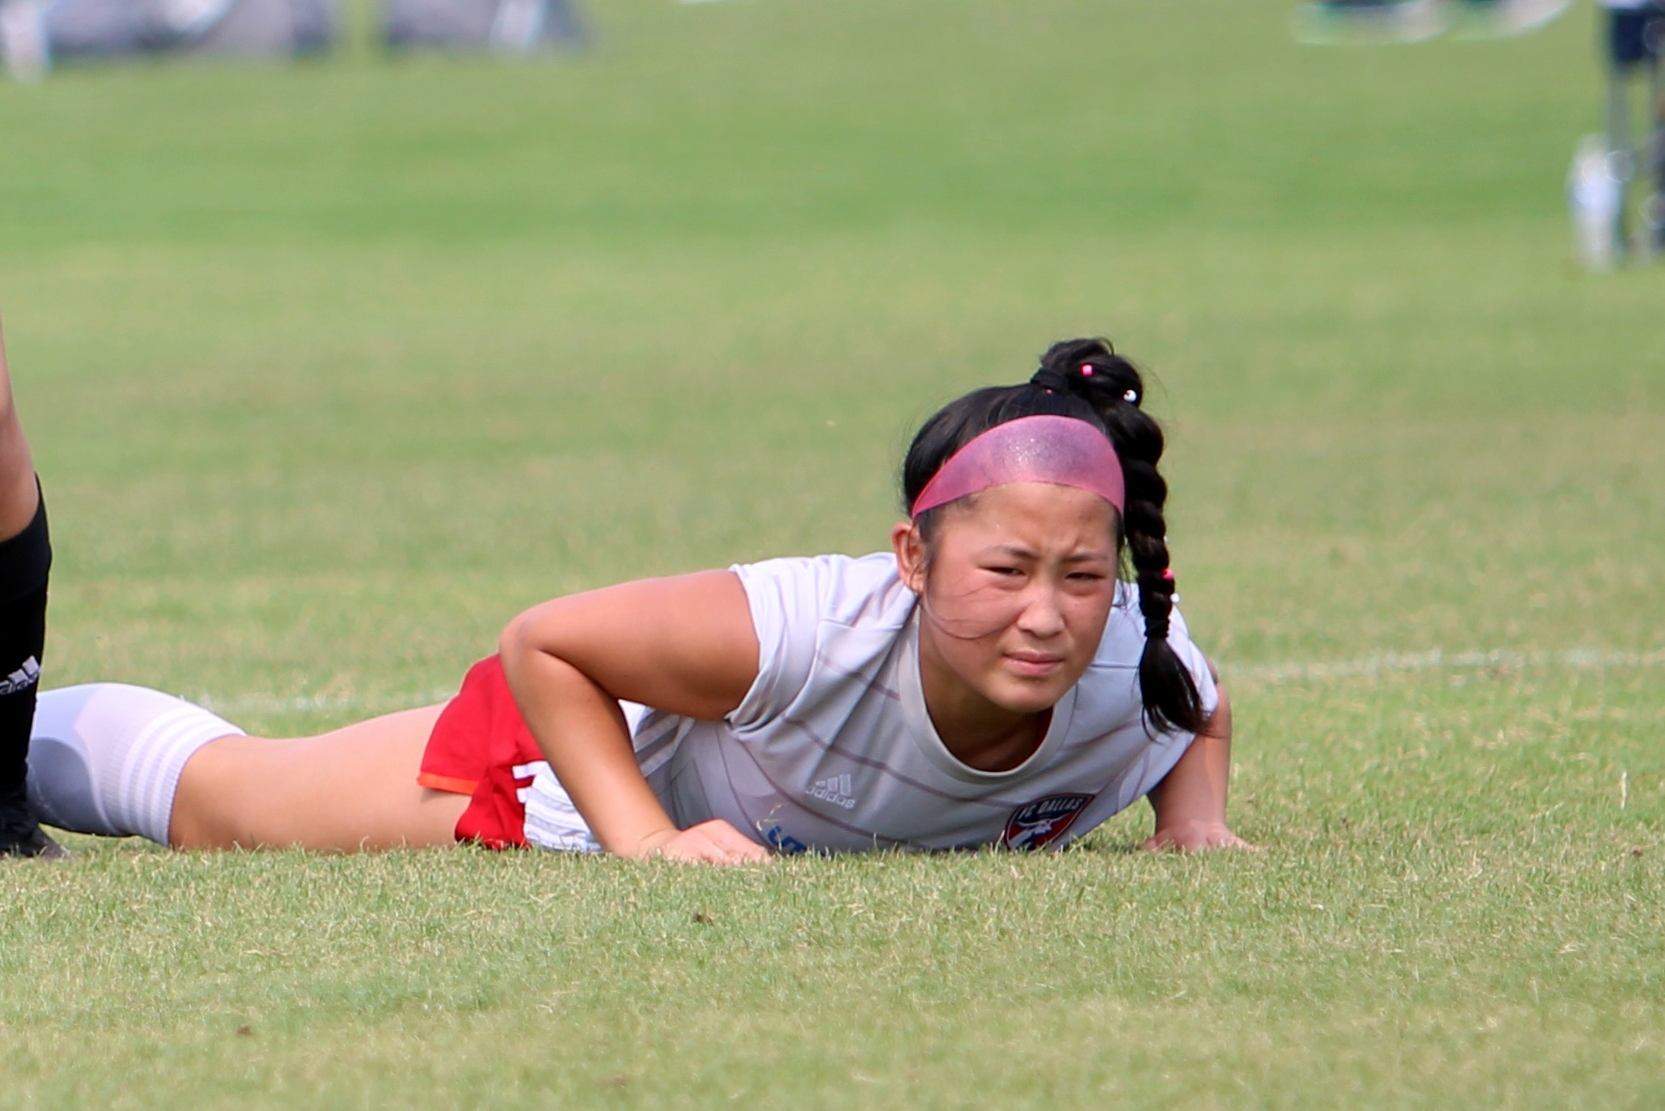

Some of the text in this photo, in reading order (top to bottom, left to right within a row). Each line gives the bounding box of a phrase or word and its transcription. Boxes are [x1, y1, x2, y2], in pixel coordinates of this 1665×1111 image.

[805, 786, 855, 809] adidas
[1018, 798, 1083, 819] FC DALLAS
